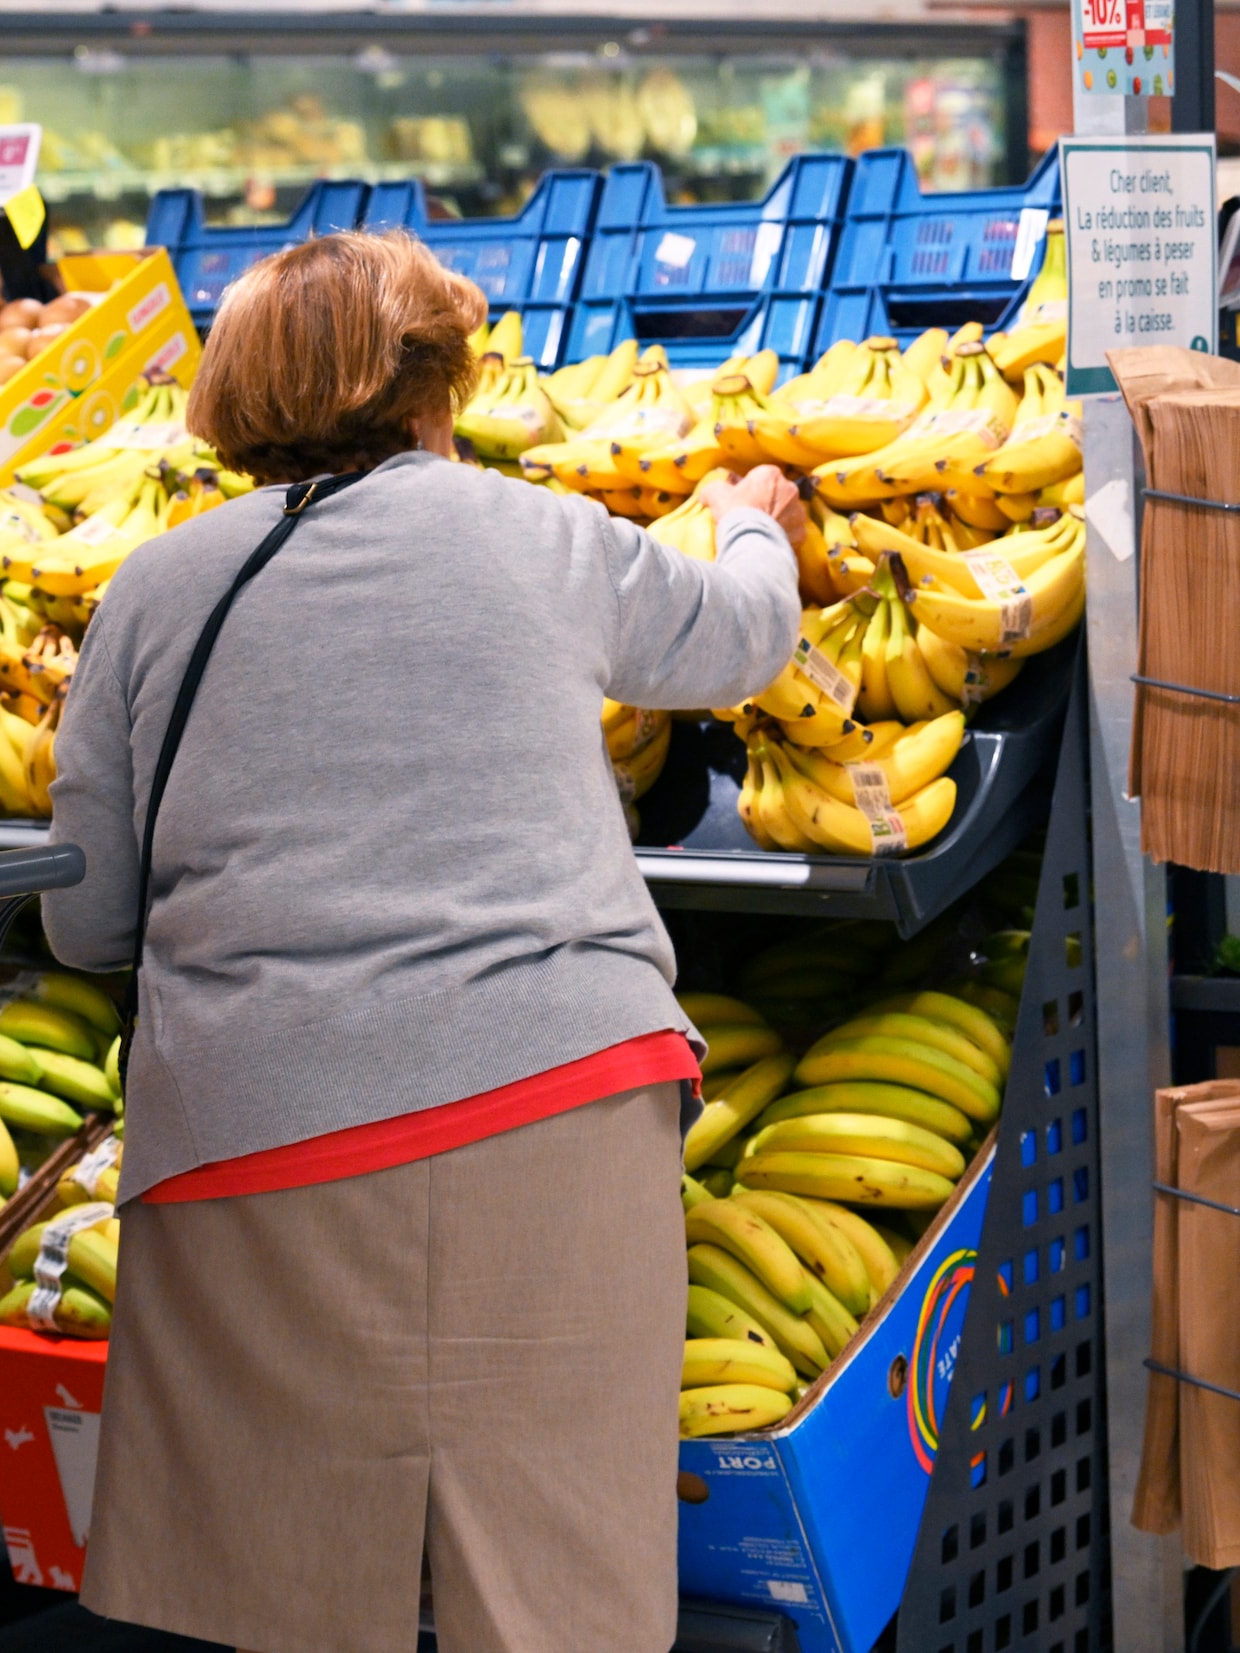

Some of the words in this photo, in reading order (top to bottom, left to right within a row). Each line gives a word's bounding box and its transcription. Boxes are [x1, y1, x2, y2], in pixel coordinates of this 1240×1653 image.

[1084, 0, 1122, 25] -10%
[1110, 169, 1137, 193] Cher
[1140, 169, 1174, 196] client,
[1077, 206, 1092, 230] La
[1096, 205, 1150, 229] réduction
[1153, 205, 1172, 228] des
[1175, 204, 1205, 227] fruits
[1092, 238, 1100, 262] &
[1104, 238, 1151, 269] légumes
[1155, 236, 1161, 260] à
[1165, 242, 1194, 266] peser
[1099, 280, 1112, 298] en
[1116, 279, 1152, 304] promo
[1155, 278, 1167, 296] se
[1171, 271, 1189, 296] fait
[1115, 310, 1121, 334] à
[1125, 310, 1135, 333] la
[1138, 307, 1175, 332] caisse.
[719, 1456, 777, 1470] PORT
